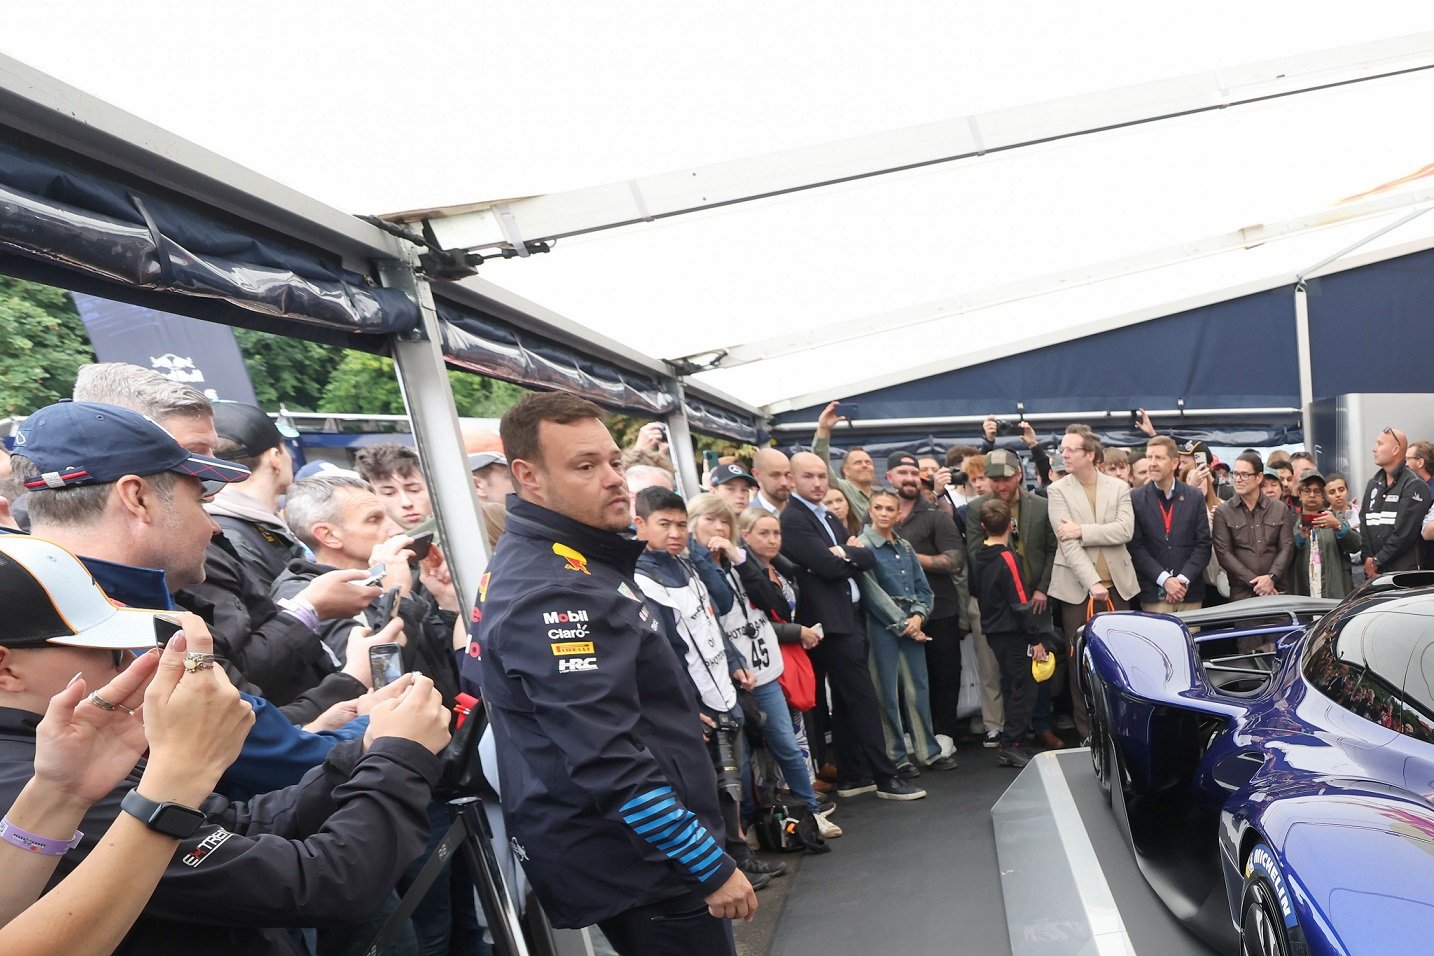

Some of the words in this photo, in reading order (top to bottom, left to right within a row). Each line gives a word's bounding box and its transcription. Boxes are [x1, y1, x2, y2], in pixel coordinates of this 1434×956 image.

[543, 610, 589, 625] Mobil
[547, 626, 587, 640] Claro
[750, 638, 770, 671] 45
[558, 657, 598, 672] HRC
[1253, 848, 1291, 917] MICHELIN
